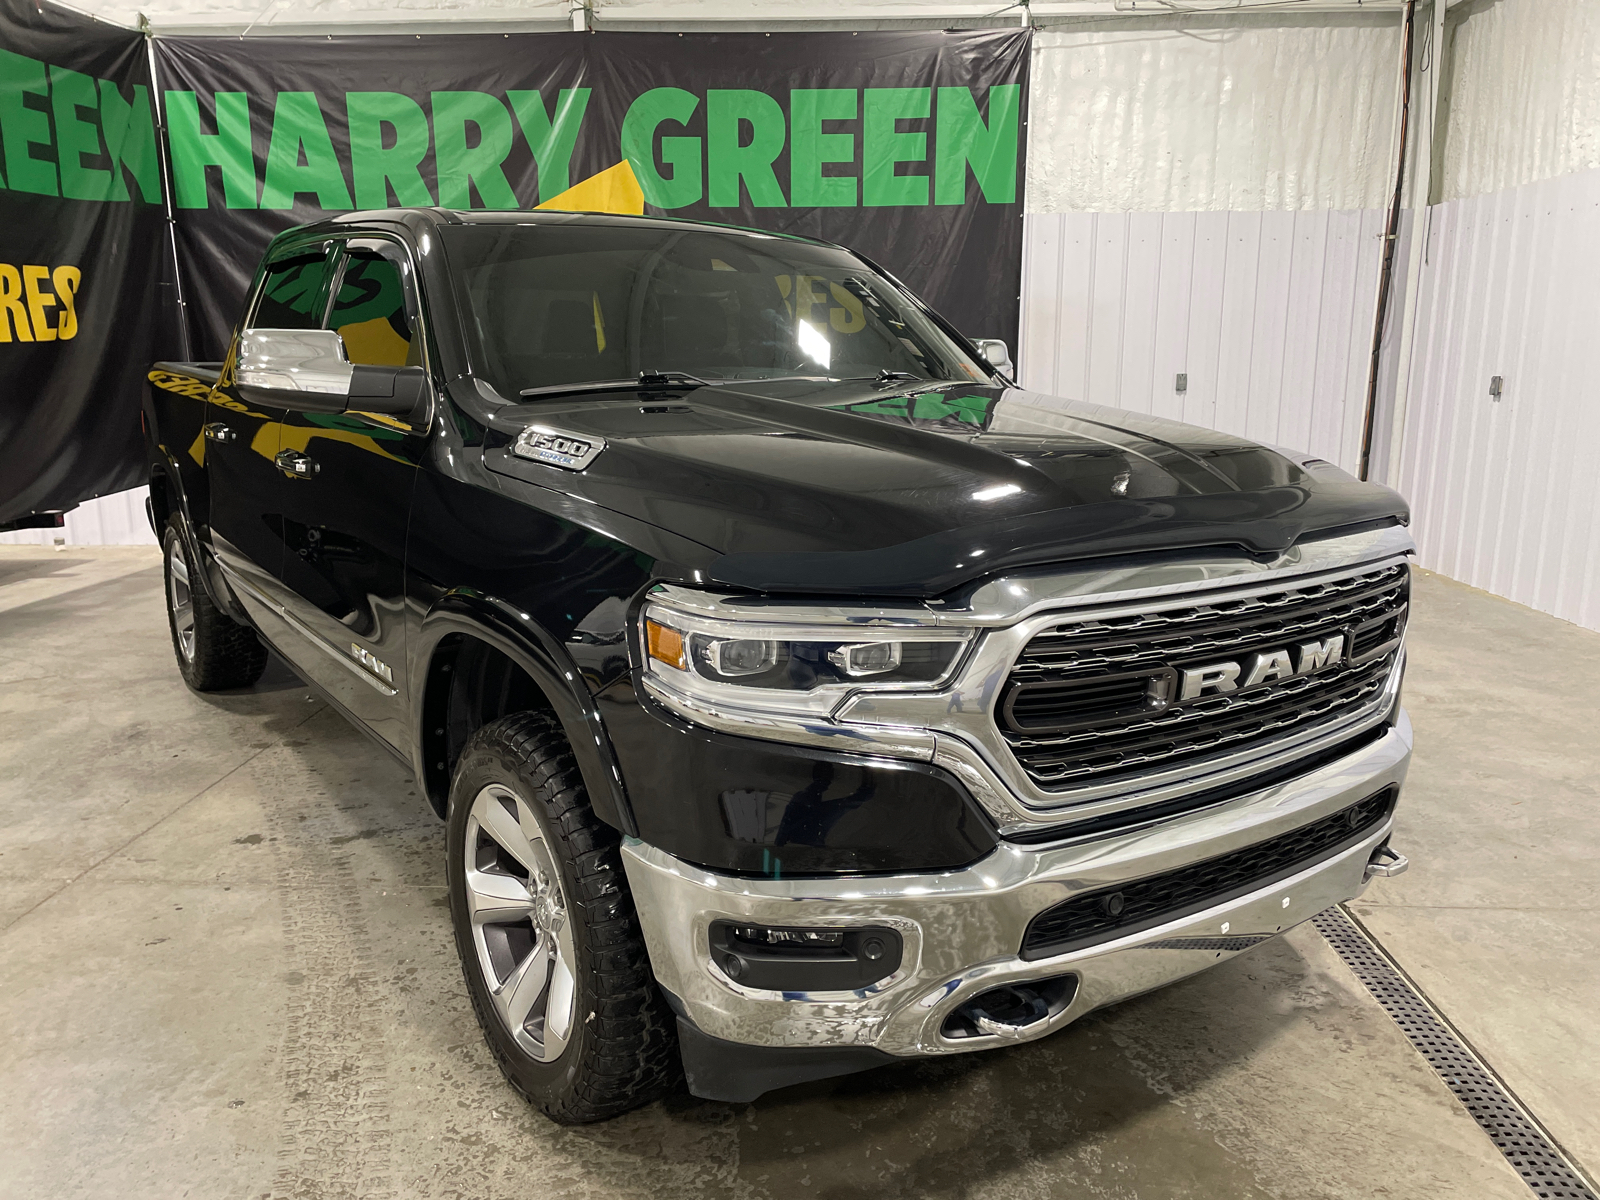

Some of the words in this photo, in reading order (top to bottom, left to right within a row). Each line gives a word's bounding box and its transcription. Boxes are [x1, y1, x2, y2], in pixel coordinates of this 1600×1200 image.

[164, 88, 592, 210] HARRY
[621, 84, 1020, 209] GREEN
[530, 433, 591, 457] 1500
[1180, 634, 1344, 700] RAM
